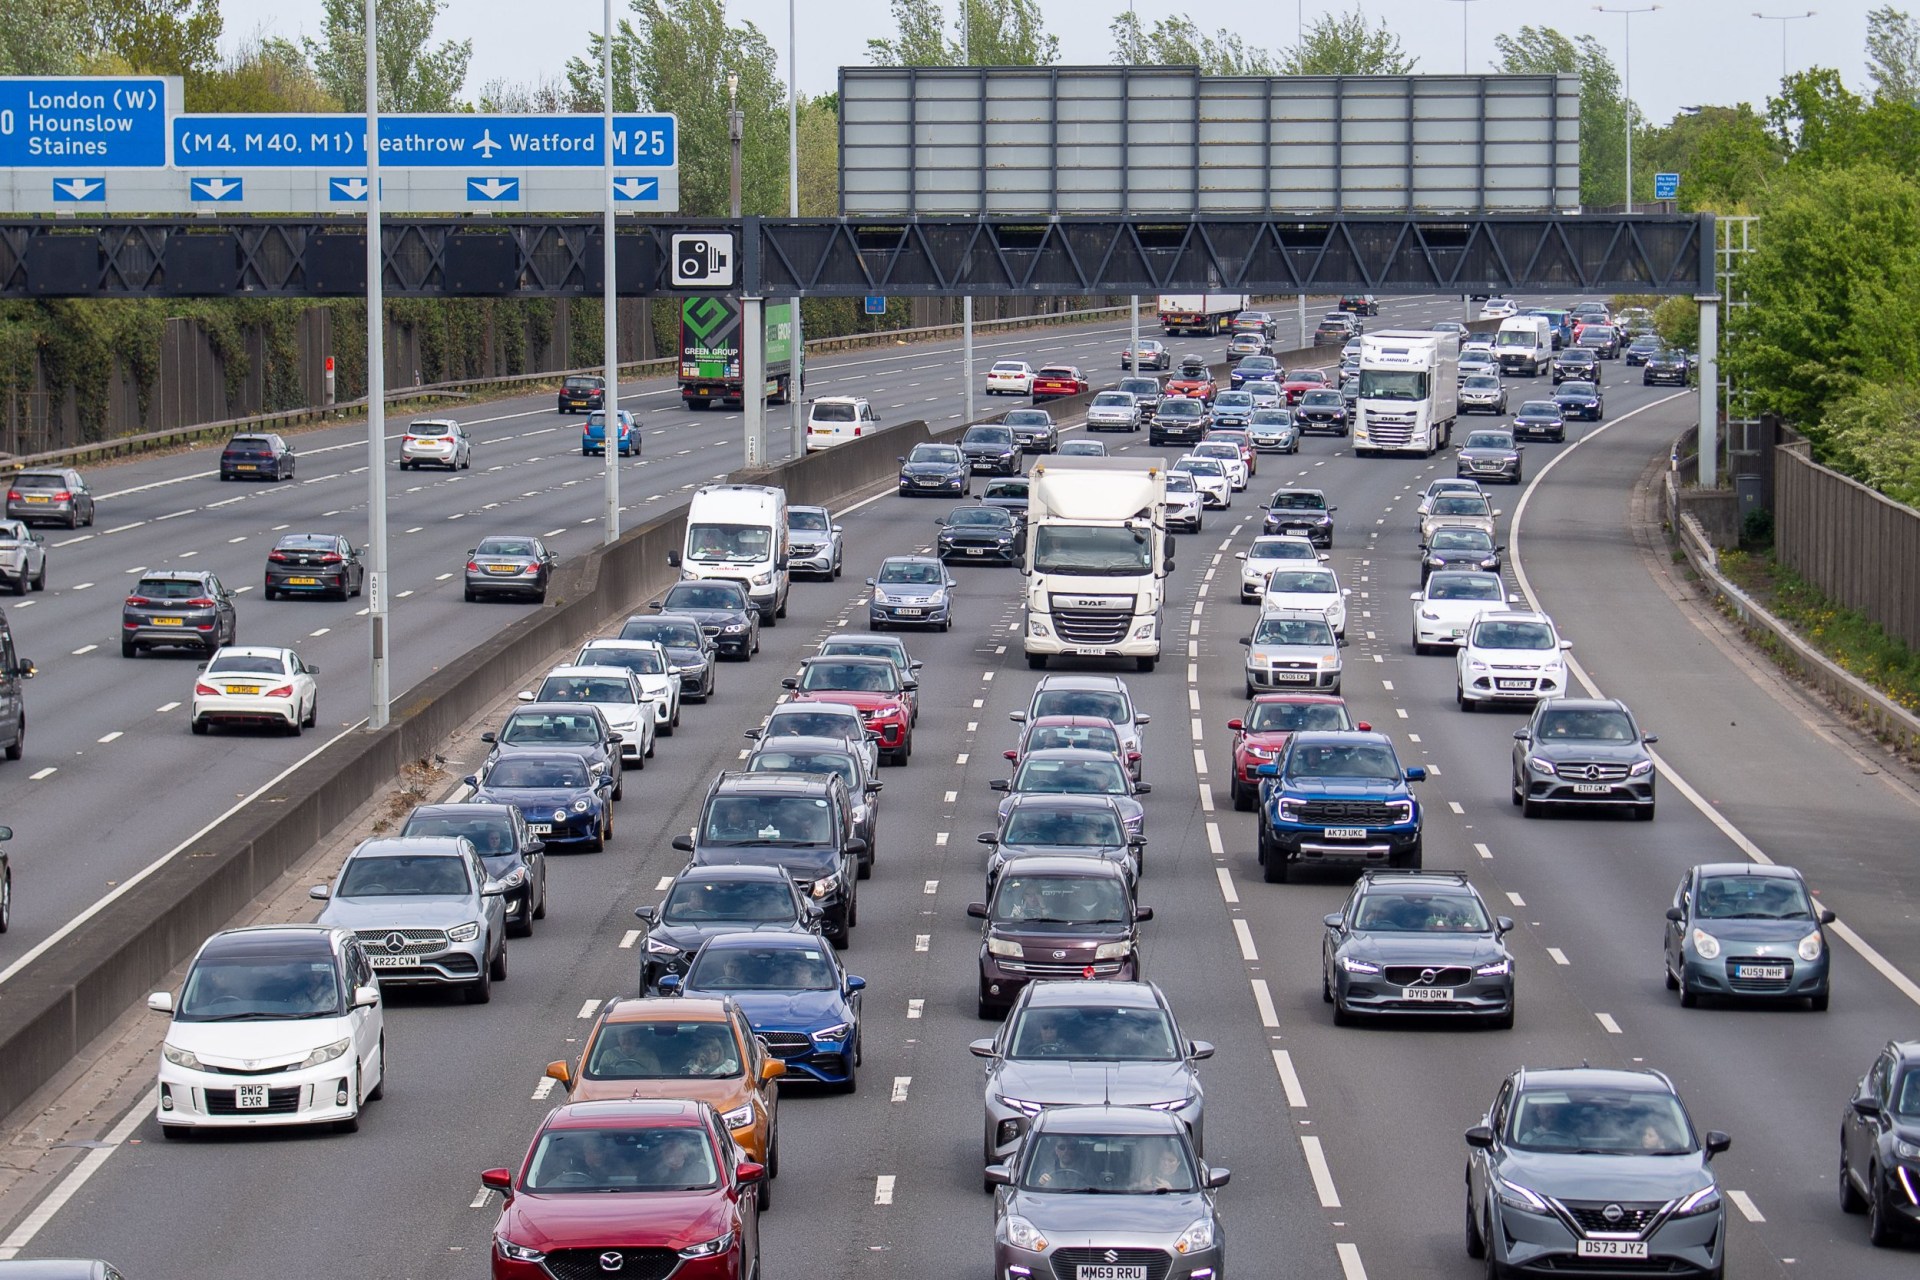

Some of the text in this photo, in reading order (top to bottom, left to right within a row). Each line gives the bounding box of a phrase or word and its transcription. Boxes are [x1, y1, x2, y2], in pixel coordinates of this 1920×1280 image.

[29, 88, 156, 111] London (W)
[29, 114, 133, 132] Hounslow
[29, 137, 107, 155] Staines
[363, 133, 465, 152] eathrow
[509, 133, 595, 151] Watford
[684, 347, 738, 356] GREEN GROUP
[373, 956, 416, 966] KR22 CVM
[1741, 967, 1783, 977] KU59 NHF
[1408, 989, 1448, 999] DY19 ORW
[241, 1086, 263, 1096] BW12
[242, 1096, 262, 1106] EXR
[1585, 1242, 1644, 1255] DS73 JYZ
[1081, 1266, 1141, 1279] MM69 RRU
